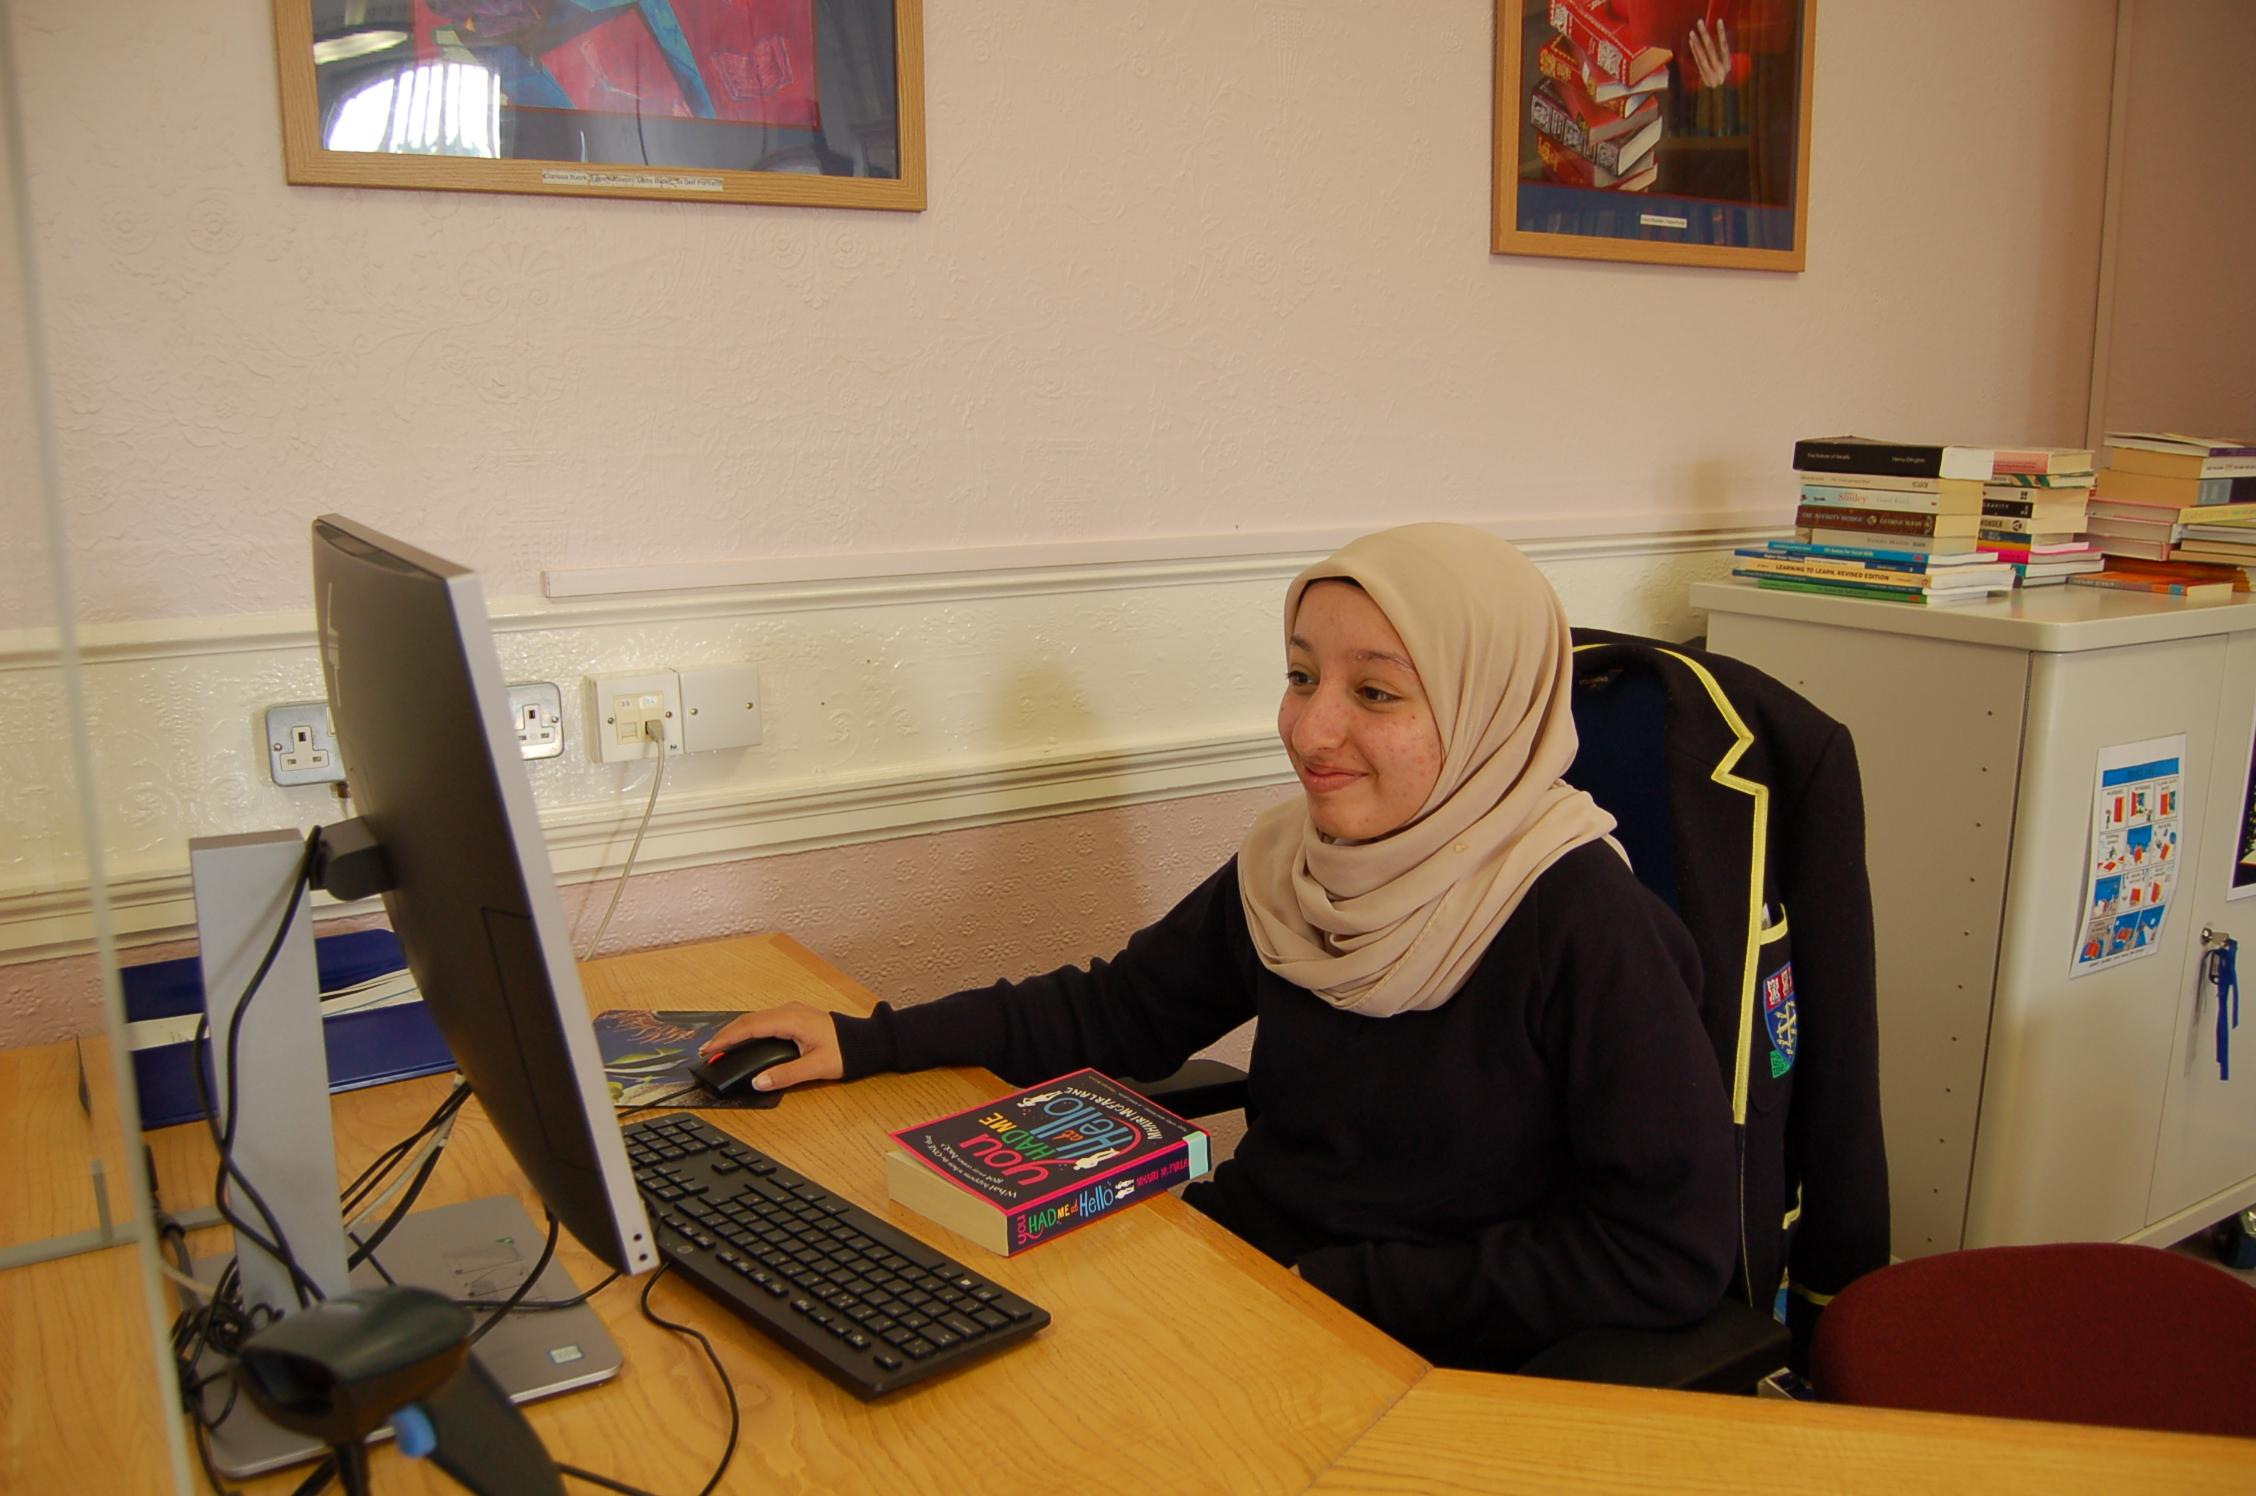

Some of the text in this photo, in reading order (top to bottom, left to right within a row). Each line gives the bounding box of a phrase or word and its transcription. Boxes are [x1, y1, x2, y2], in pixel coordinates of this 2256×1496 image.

[1775, 563, 1805, 573] LEARNING
[1837, 569, 1864, 579] REVISED
[1864, 571, 1889, 580] EDITION
[978, 1112, 1056, 1160] HAD ME
[1030, 1097, 1133, 1160] Hello
[1129, 1111, 1163, 1140] MHAIRI
[1028, 1208, 1057, 1233] HAD
[1057, 1204, 1071, 1219] ME
[1079, 1184, 1114, 1217] Hello
